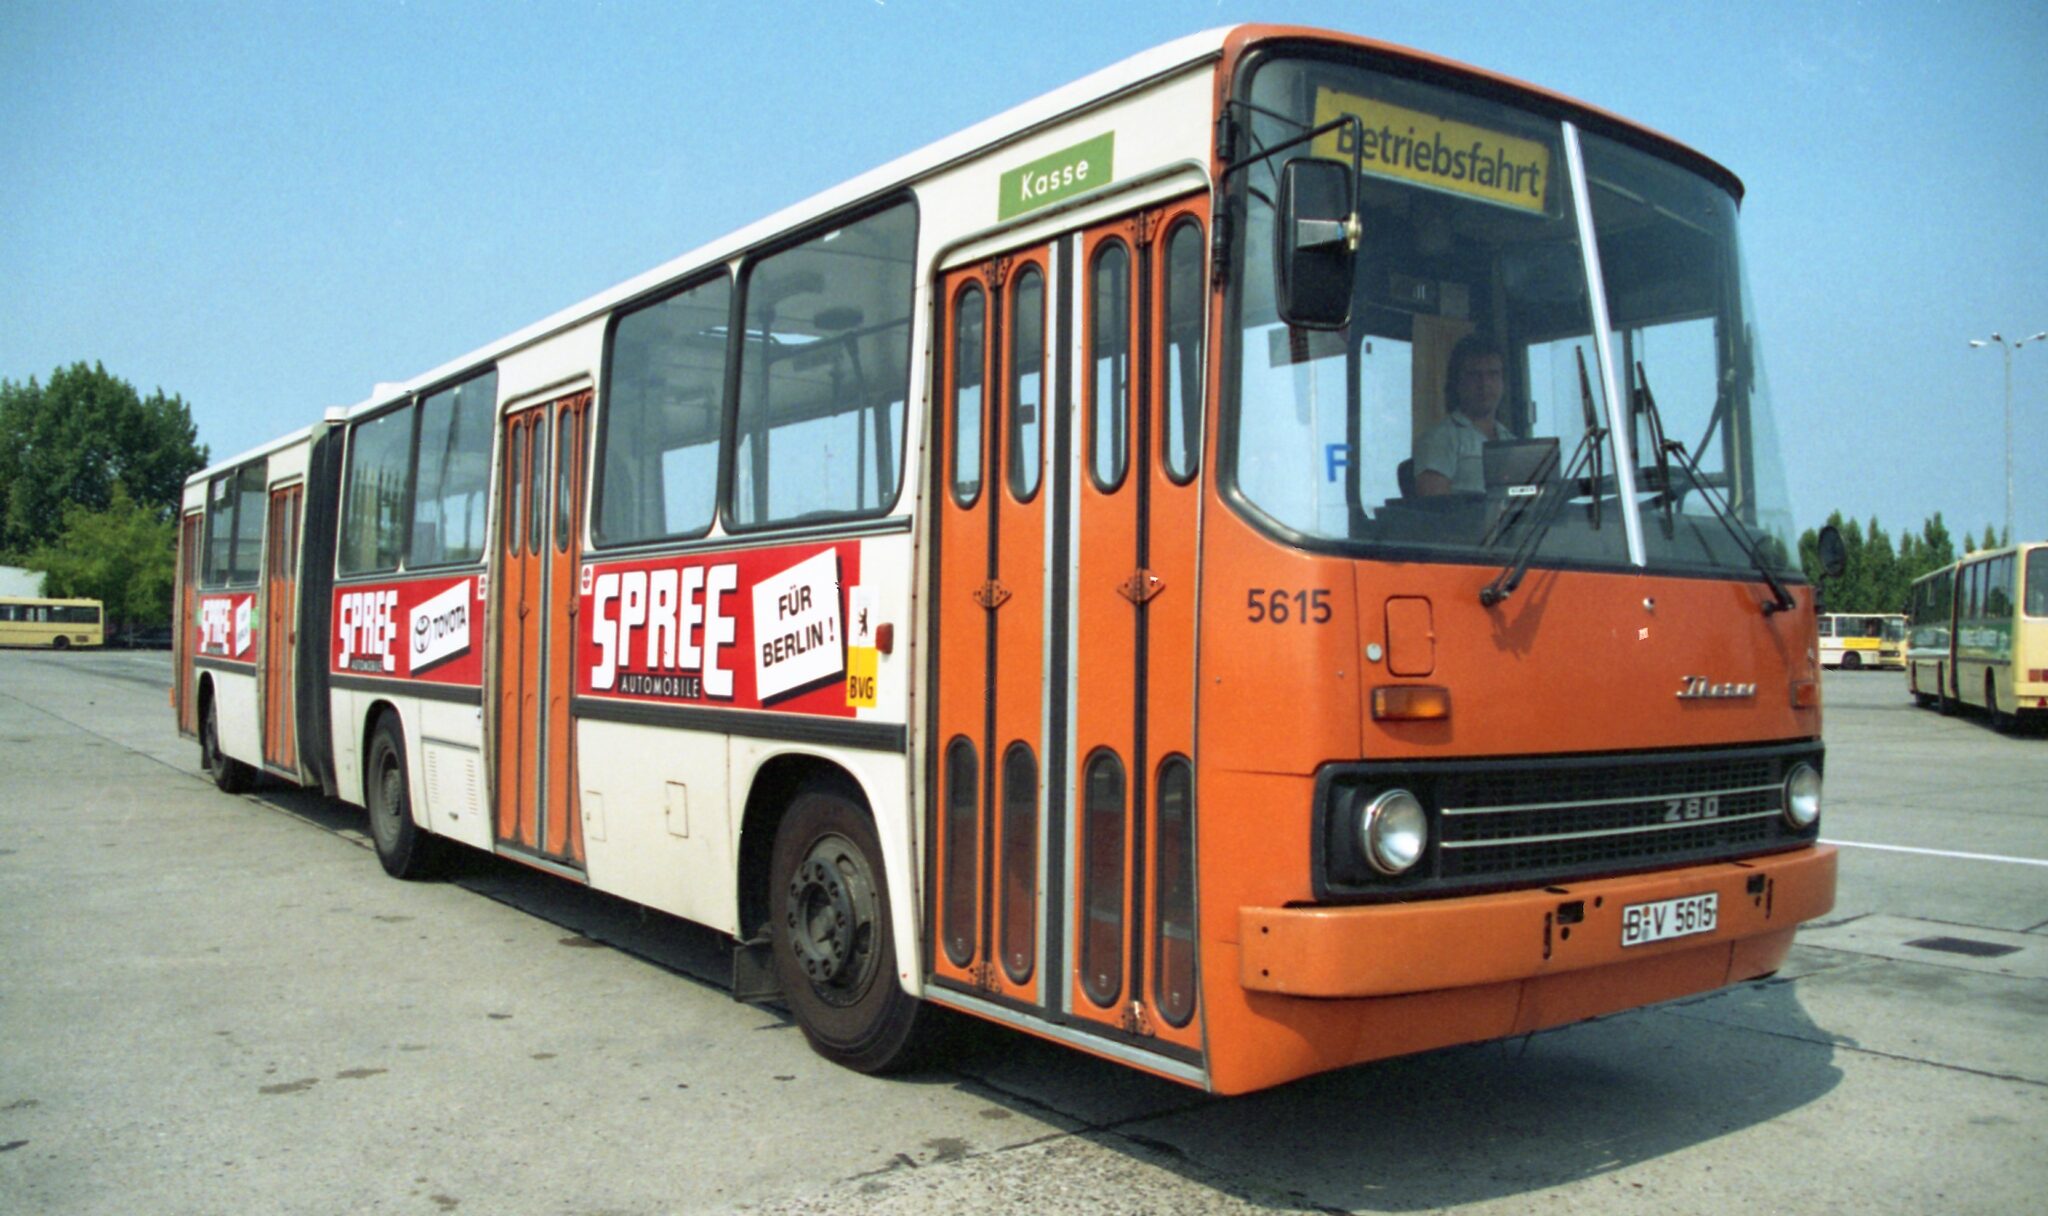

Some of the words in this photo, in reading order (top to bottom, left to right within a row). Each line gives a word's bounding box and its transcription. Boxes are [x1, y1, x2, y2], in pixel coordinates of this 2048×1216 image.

[1336, 120, 1541, 197] Betriebsfahrt
[1020, 158, 1089, 201] Kasse
[777, 583, 812, 621] FÜR
[1246, 588, 1333, 625] 5615
[338, 590, 399, 672] SPREE
[432, 603, 467, 640] TOYOTA
[591, 564, 738, 698] SPREE
[762, 624, 824, 668] BERLIN
[620, 676, 700, 700] AUTOMOBILE
[849, 675, 874, 700] BVG
[1675, 896, 1713, 932] 5615
